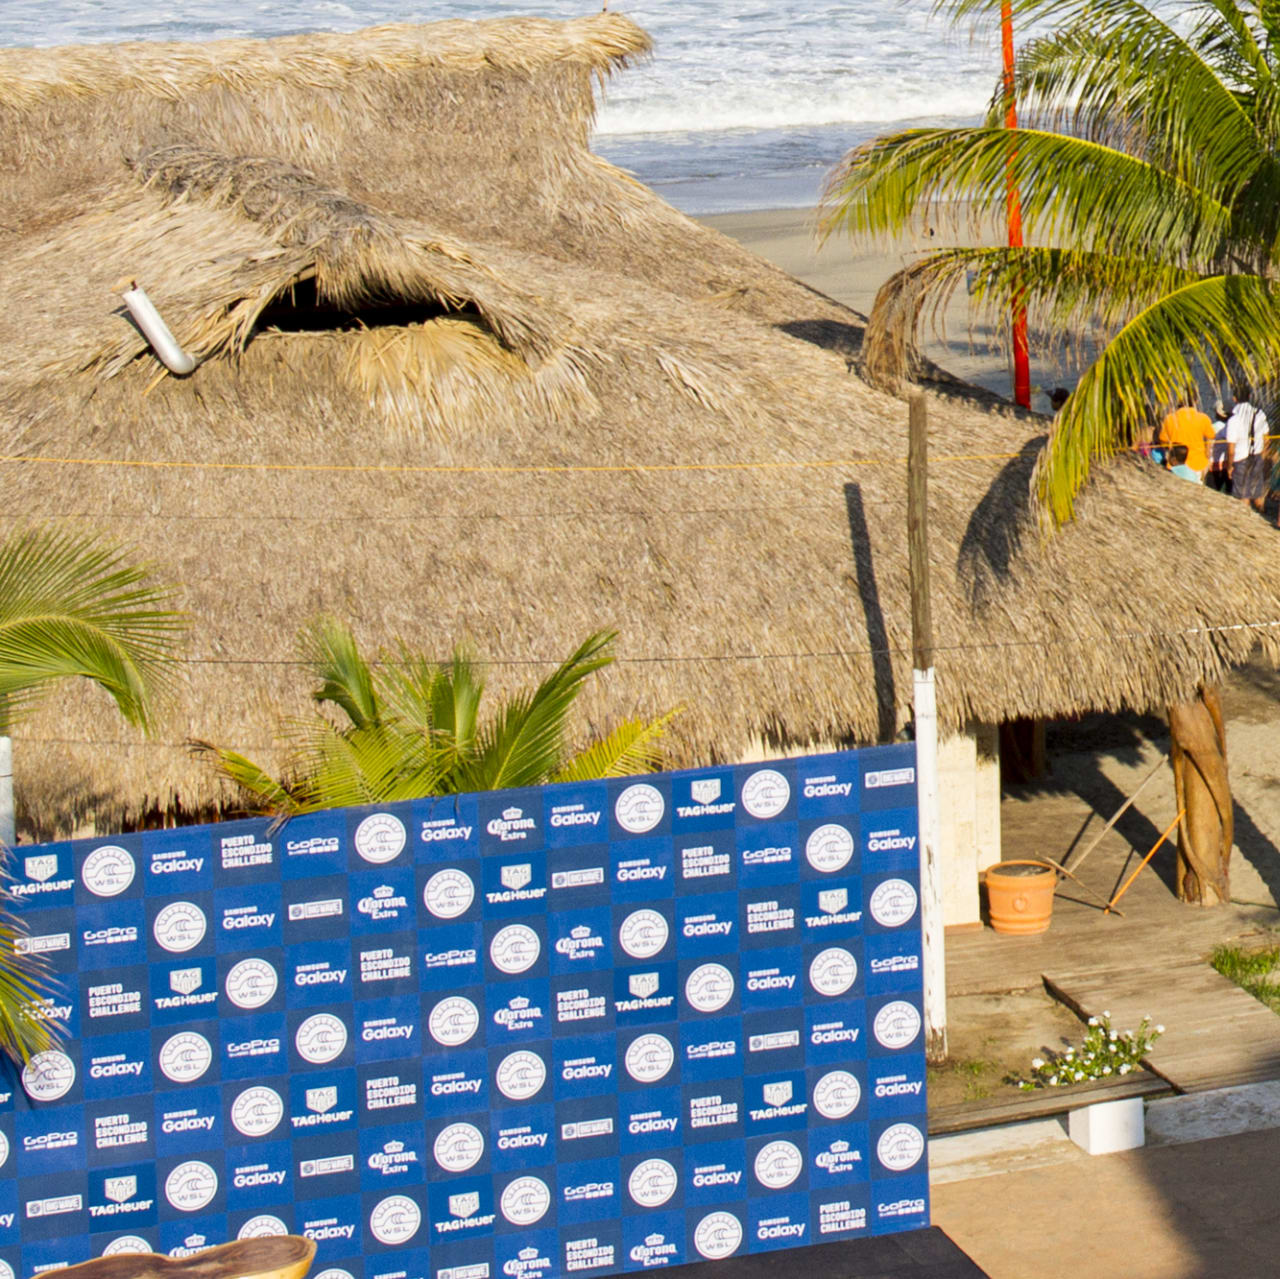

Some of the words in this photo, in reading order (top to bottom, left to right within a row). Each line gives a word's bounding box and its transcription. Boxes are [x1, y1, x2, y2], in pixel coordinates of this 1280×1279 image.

[804, 781, 852, 798] Galaxy
[487, 816, 535, 835] Corona
[550, 810, 600, 827] Galaxy
[221, 835, 255, 847] PUERTO
[421, 825, 472, 842] Galaxy
[500, 830, 526, 841] Extra
[221, 842, 272, 859] ESCONDIDO
[287, 838, 339, 849] GoPro
[682, 846, 714, 857] PUERTO
[868, 835, 916, 852] Galaxy
[222, 853, 272, 869] CHALLENGE
[682, 853, 730, 869] ESCONDIDO
[743, 848, 791, 859] GoPro
[151, 857, 203, 874] Galaxy
[617, 864, 666, 881] Galaxy
[682, 863, 730, 879] CHALLENGE
[357, 894, 407, 913] Corona
[747, 901, 778, 912] PUERTO
[222, 912, 275, 929] Galaxy
[371, 908, 398, 919] Extra
[747, 908, 794, 923] ESCONDIDO
[84, 927, 137, 939] GoPro
[683, 920, 732, 937] Galaxy
[747, 918, 794, 933] CHALLENGE
[555, 935, 603, 954] Corona
[360, 949, 394, 960] PUERTO
[425, 950, 476, 961] GoPro
[568, 949, 594, 960] Extra
[871, 955, 918, 967] GoPro
[360, 956, 411, 972] ESCONDIDO
[295, 969, 346, 986] Galaxy
[361, 966, 411, 982] CHALLENGE
[88, 984, 123, 996] PUERTO
[747, 974, 795, 991] Galaxy
[88, 991, 141, 1008] ESCONDIDO
[557, 989, 589, 1000] PUERTO
[89, 1002, 141, 1018] CHALLENGE
[557, 996, 605, 1012] ESCONDIDO
[494, 1006, 542, 1024] Corona
[557, 1006, 605, 1022] CHALLENGE
[362, 1024, 413, 1041] Galaxy
[507, 1019, 533, 1030] Extra
[811, 1027, 859, 1044] Galaxy
[227, 1039, 279, 1051] GoPro
[687, 1041, 735, 1053] GoPro
[90, 1061, 143, 1078] Galaxy
[562, 1063, 611, 1080] Galaxy
[366, 1077, 399, 1088] PUERTO
[431, 1078, 481, 1096] Galaxy
[875, 1080, 922, 1097] Galaxy
[366, 1084, 416, 1100] ESCONDIDO
[367, 1094, 416, 1110] CHALLENGE
[690, 1096, 722, 1107] PUERTO
[690, 1103, 738, 1118] ESCONDIDO
[95, 1114, 129, 1126] PUERTO
[162, 1115, 214, 1133] Galaxy
[629, 1117, 677, 1134] Galaxy
[690, 1113, 738, 1128] CHALLENGE
[24, 1132, 77, 1144] GoPro
[95, 1122, 147, 1138] ESCONDIDO
[96, 1132, 147, 1149] CHALLENGE
[498, 1132, 547, 1149] Galaxy
[368, 1150, 417, 1168] Corona
[815, 1149, 861, 1167] Corona
[382, 1163, 408, 1174] Extra
[828, 1162, 853, 1173] Extra
[234, 1170, 285, 1187] Galaxy
[693, 1170, 741, 1187] Galaxy
[564, 1183, 613, 1195] GoPro
[819, 1201, 850, 1212] PUERTO
[878, 1199, 925, 1210] GoPro
[819, 1208, 866, 1224] ESCONDIDO
[303, 1224, 355, 1241] Galaxy
[757, 1223, 805, 1240] Galaxy
[819, 1218, 866, 1234] CHALLENGE
[566, 1238, 598, 1249] PUERTO
[630, 1242, 677, 1260] Corona
[566, 1245, 614, 1261] ESCONDIDO
[643, 1255, 669, 1266] Extra
[503, 1257, 551, 1276] Corona
[566, 1255, 614, 1271] CHALLENGE
